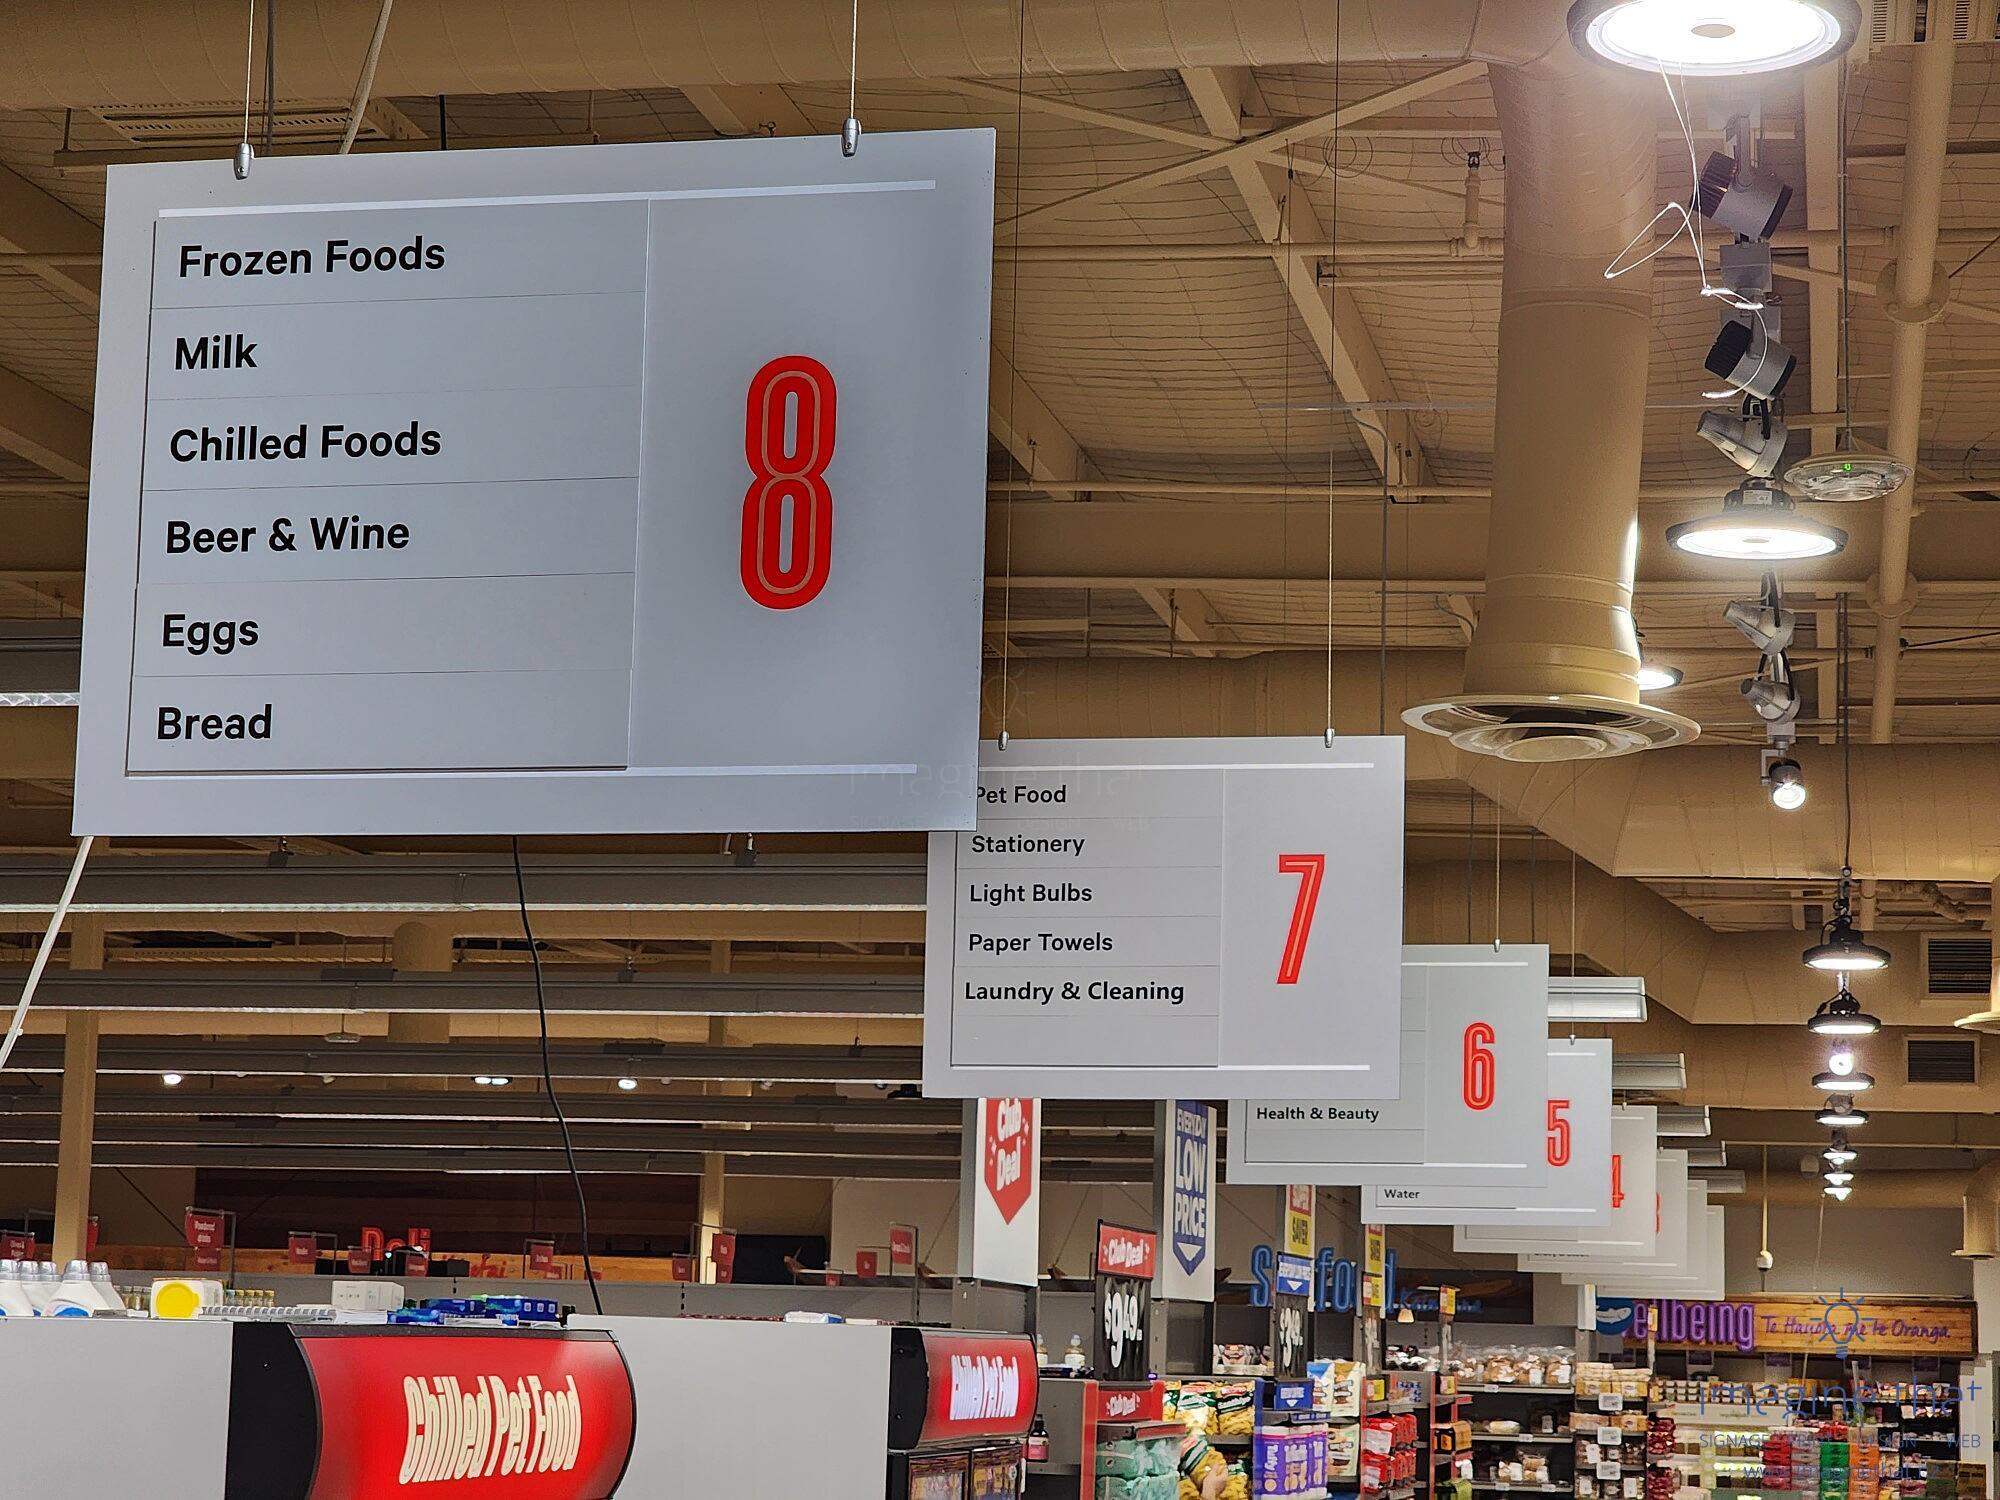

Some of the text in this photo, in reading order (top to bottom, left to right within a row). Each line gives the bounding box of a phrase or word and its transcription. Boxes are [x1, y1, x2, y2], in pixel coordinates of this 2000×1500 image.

[179, 235, 445, 278] Frozen Foods
[175, 333, 258, 370] Milk
[170, 420, 441, 463] Chilled Foods
[740, 355, 837, 610] 8
[166, 515, 410, 554] Beer & Wine
[162, 613, 259, 656] Eggs
[157, 703, 272, 740] Bread
[1014, 784, 1067, 804] Food
[971, 834, 1085, 857] Stationery
[970, 882, 1093, 907] Light Bulbs
[1276, 854, 1325, 985] 7
[968, 931, 1113, 956] Paper Towels
[965, 980, 1185, 1006] Laundry & Cleaning
[1463, 1021, 1496, 1111] 6
[997, 1098, 1022, 1142] Club
[1256, 1106, 1380, 1124] Health & Beauty
[1546, 1098, 1572, 1168] 5
[996, 1136, 1021, 1191] Deal
[1175, 1135, 1206, 1194] LOW
[1174, 1192, 1206, 1238] PRICE
[1383, 1188, 1420, 1199] Water
[1108, 1237, 1144, 1267] Club Deal
[1250, 1245, 1397, 1313] Sfod
[1622, 1298, 1755, 1351] elbeing
[1760, 1315, 1777, 1333] Te
[1871, 1316, 1887, 1337] te
[399, 1375, 582, 1484] Chilled Pet Food
